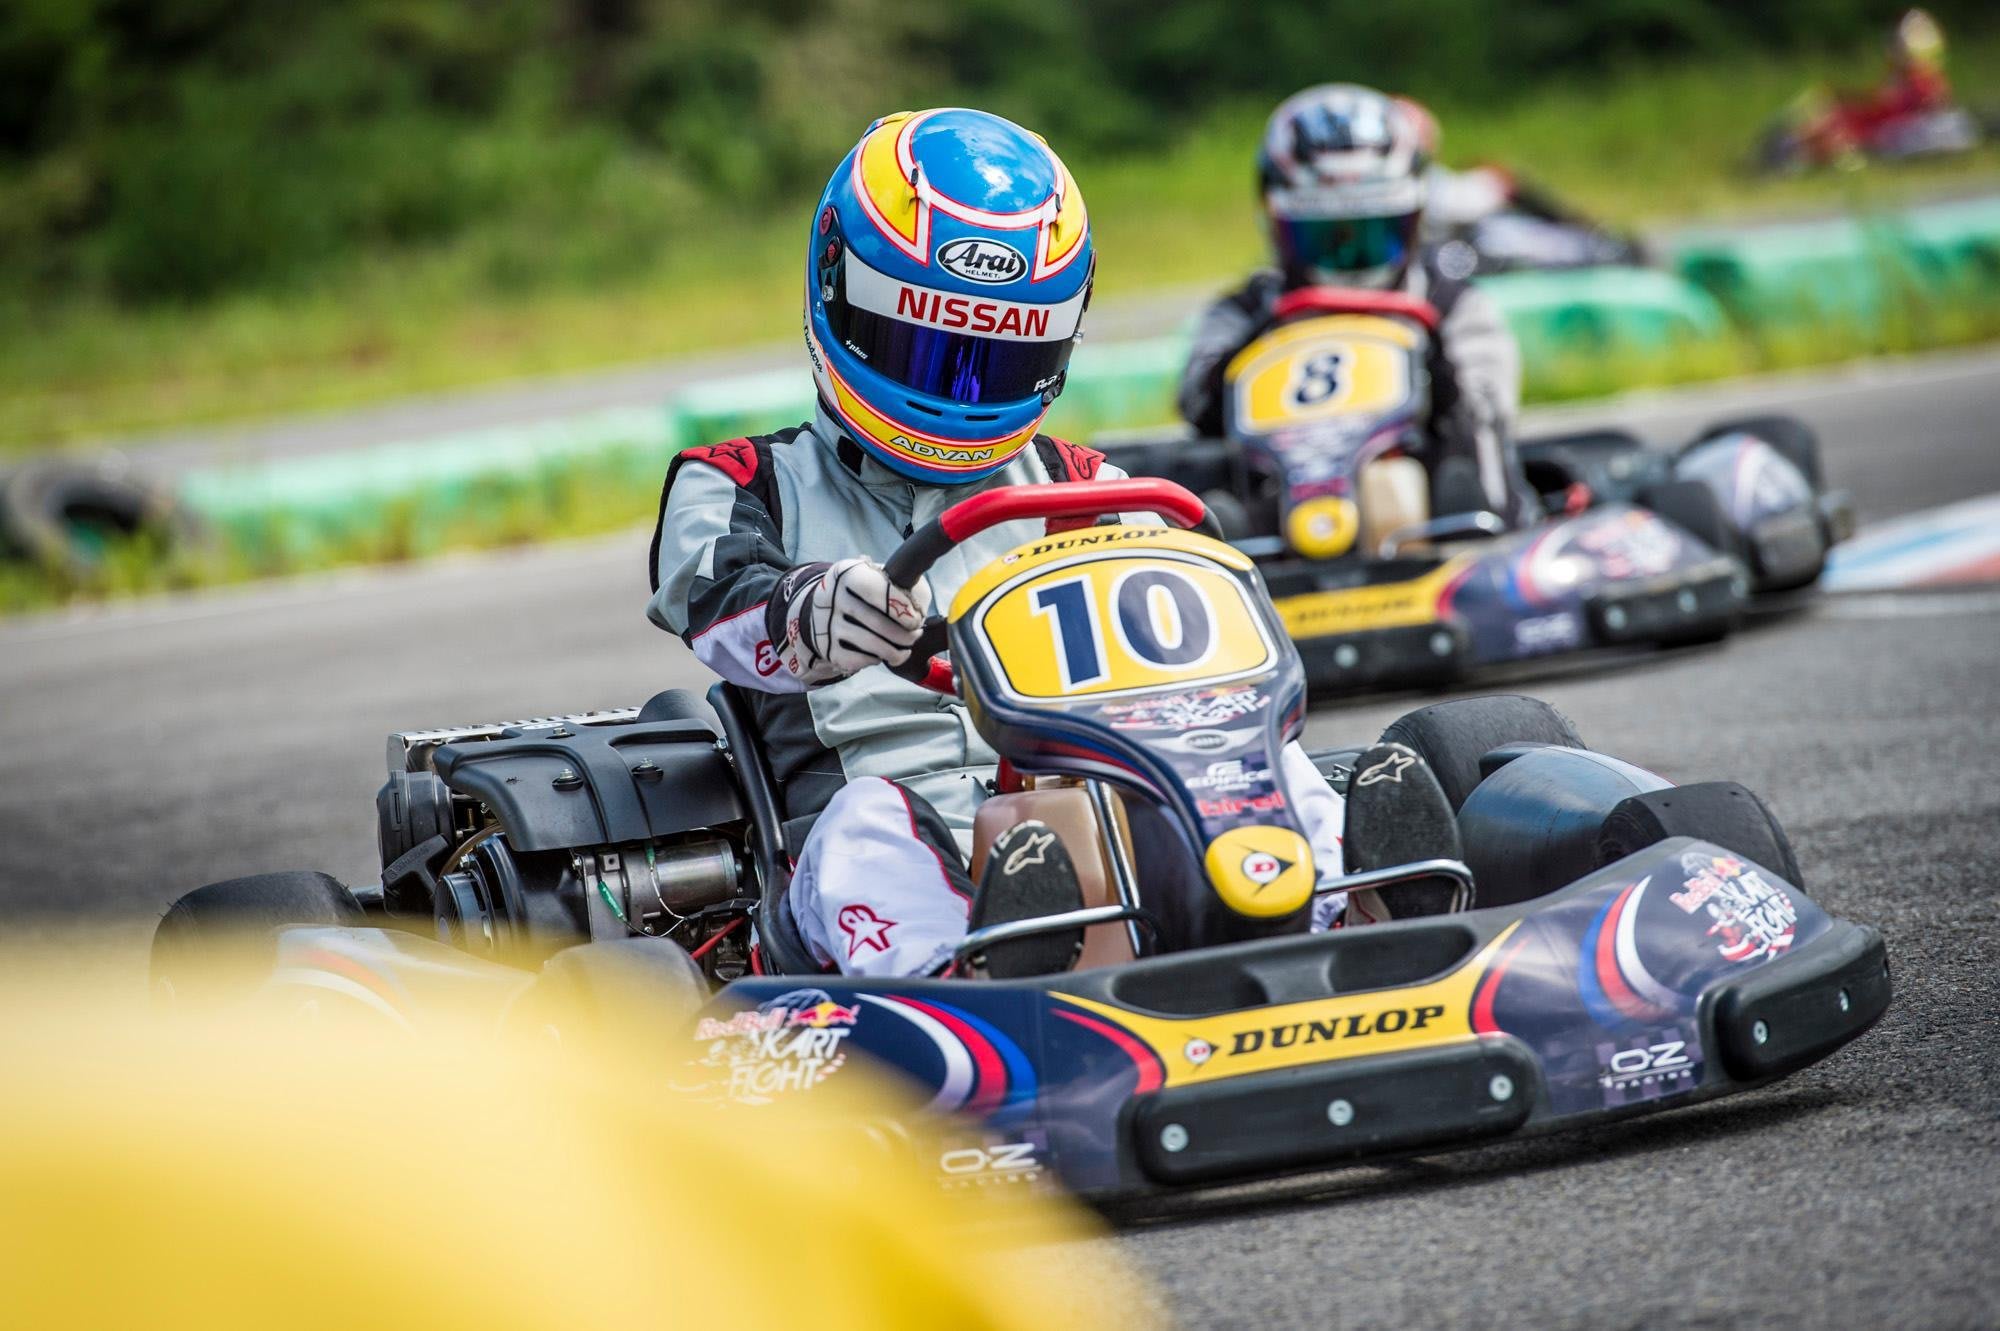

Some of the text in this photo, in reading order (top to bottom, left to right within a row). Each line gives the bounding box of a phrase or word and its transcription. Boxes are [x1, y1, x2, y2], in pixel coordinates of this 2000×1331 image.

[944, 243, 1016, 273] Arai
[896, 286, 1050, 337] NISSAN
[1295, 353, 1341, 404] 8
[890, 435, 993, 461] ADVAN
[1030, 528, 1168, 557] DUNLOP
[1033, 567, 1214, 688] 10
[757, 1027, 851, 1060] KART
[1228, 1005, 1444, 1056] DUNLOP
[729, 1058, 824, 1097] FIGHT
